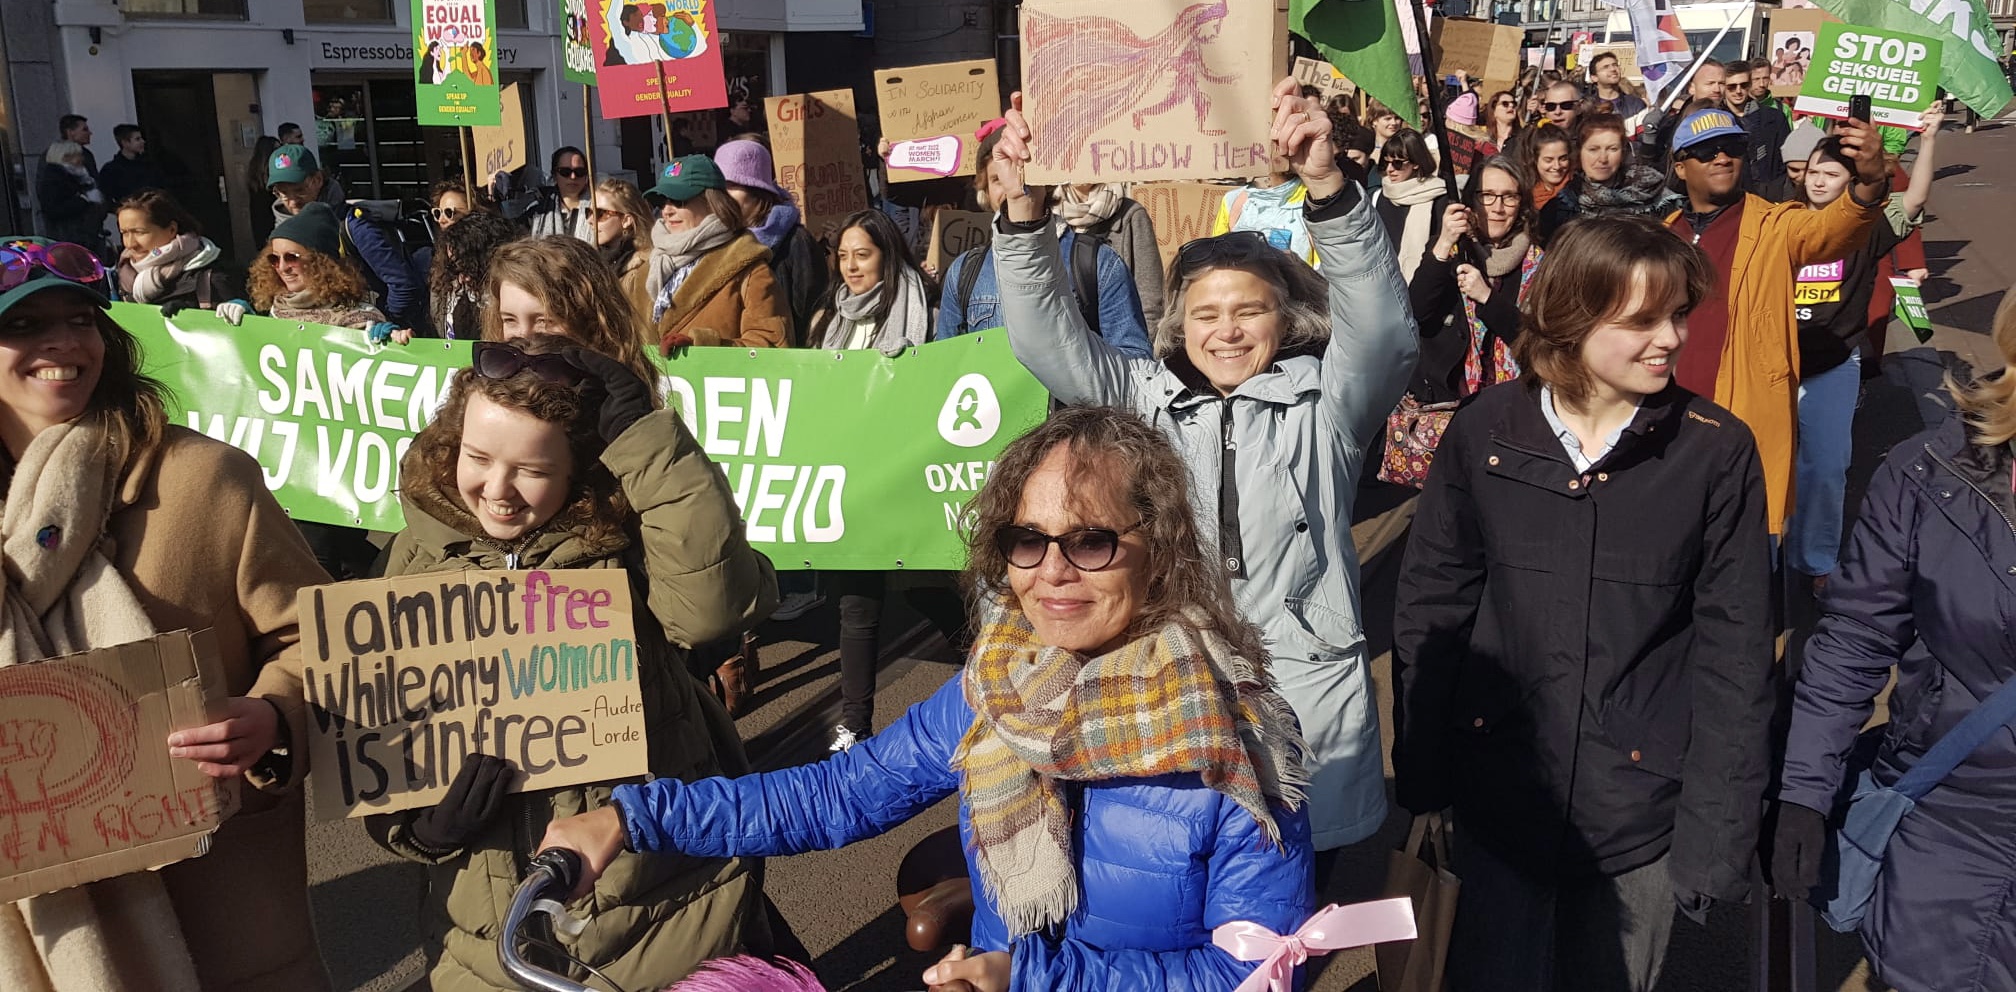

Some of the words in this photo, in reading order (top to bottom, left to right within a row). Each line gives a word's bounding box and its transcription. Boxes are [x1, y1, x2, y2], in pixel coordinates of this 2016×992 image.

[426, 4, 481, 24] EQUAL
[665, 0, 700, 11] WORLD
[1834, 32, 1927, 67] STOP
[1299, 60, 1332, 87] The
[1828, 60, 1922, 85] SEKSUEEL
[887, 86, 907, 101] IN
[917, 80, 984, 101] SOLIDARITY
[1823, 76, 1919, 103] GEWELD
[1090, 138, 1192, 176] FOLLOW
[1213, 141, 1270, 172] HER
[314, 588, 330, 662] I
[344, 589, 438, 656] am
[440, 576, 520, 642] not
[521, 571, 612, 635] free
[428, 655, 501, 714] any
[502, 638, 634, 700] woman
[591, 722, 640, 748] Lorde
[336, 730, 391, 807] is
[401, 707, 589, 792] unfree
